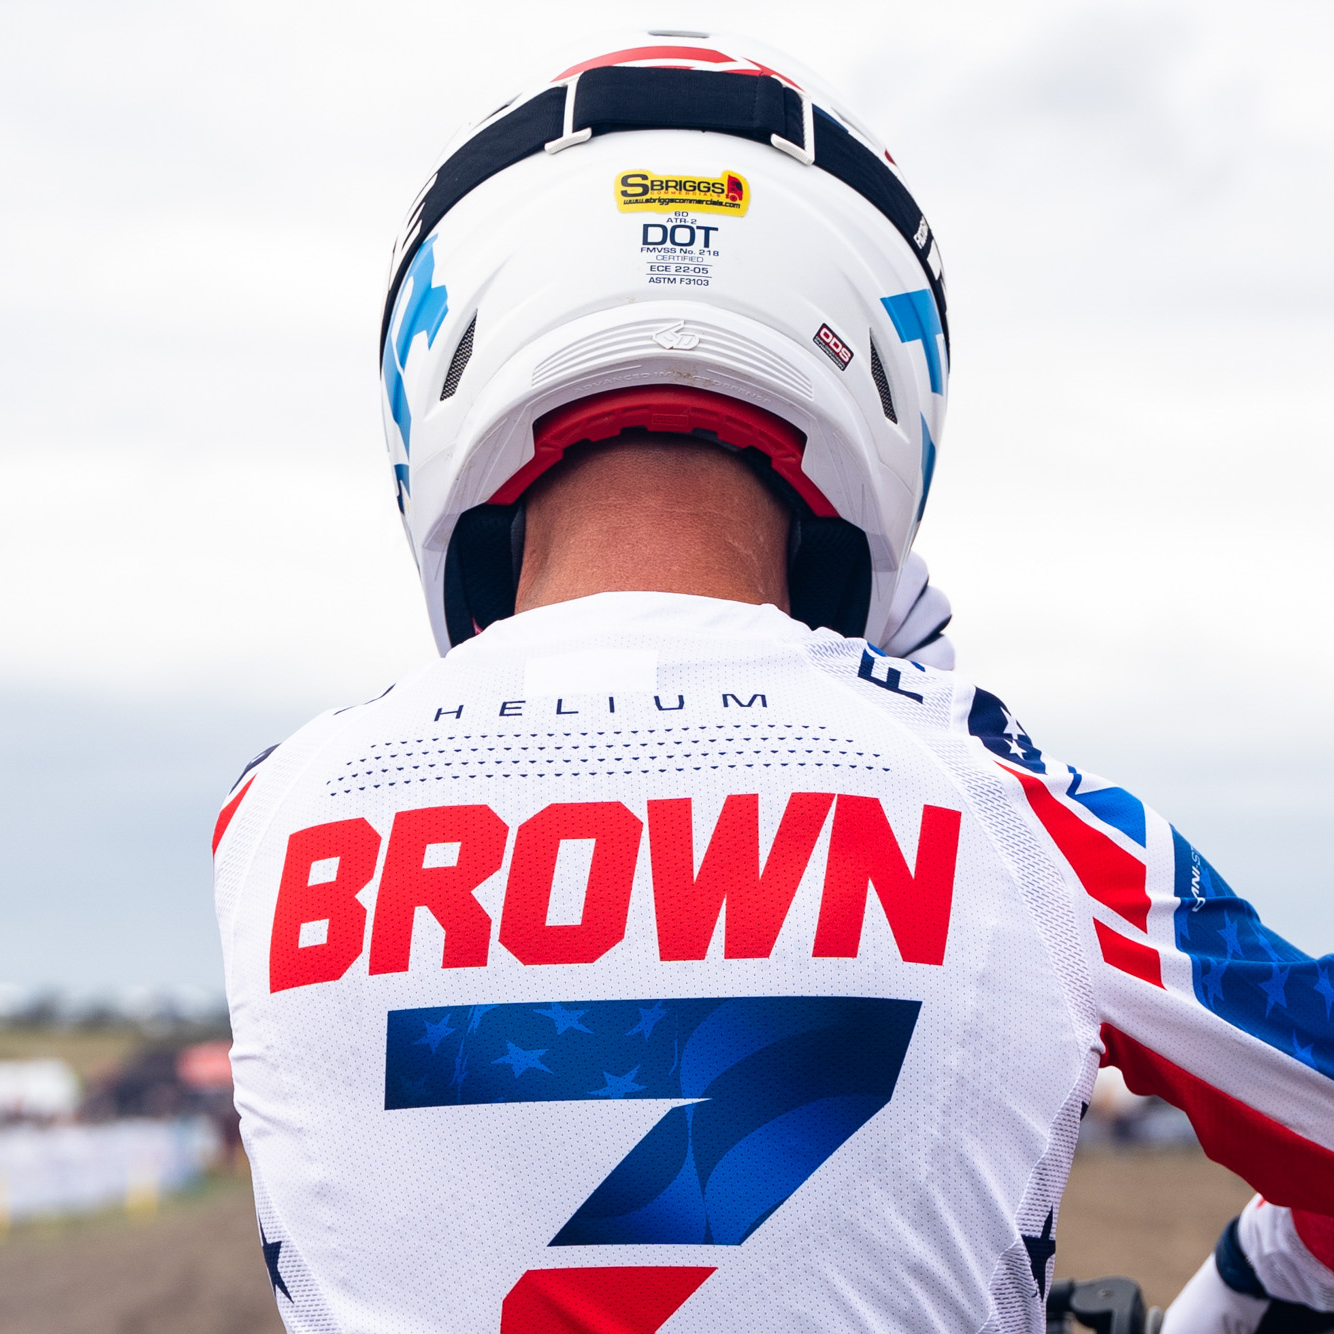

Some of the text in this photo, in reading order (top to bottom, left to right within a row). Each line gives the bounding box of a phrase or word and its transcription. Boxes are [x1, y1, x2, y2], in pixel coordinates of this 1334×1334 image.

[642, 223, 719, 249] DOT
[640, 246, 677, 255] FMVSS
[698, 249, 720, 257] 218
[655, 254, 704, 263] CERTIFIED
[649, 265, 709, 275] ECE 22-05
[648, 276, 710, 287] ASTM F3103
[819, 327, 852, 363] ODS
[433, 692, 770, 722] HELIUM
[269, 791, 962, 994] BROWN
